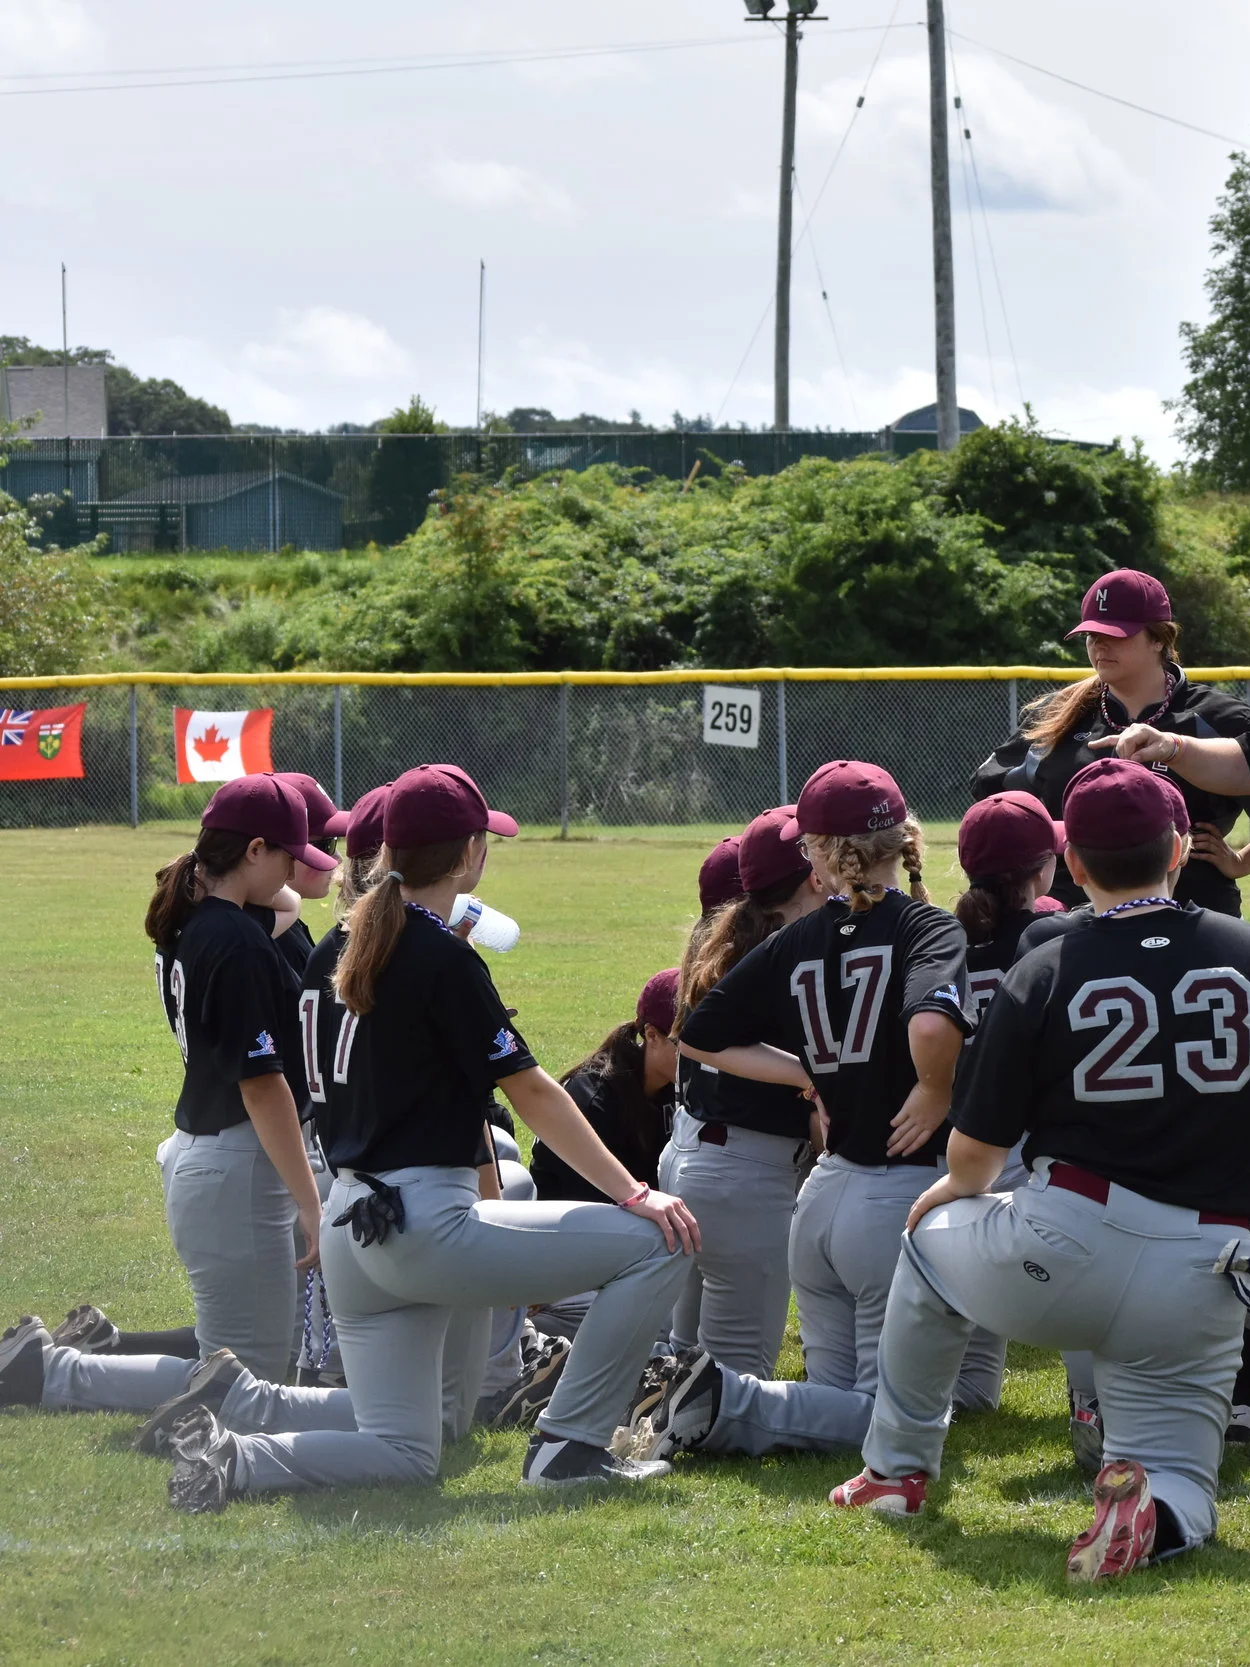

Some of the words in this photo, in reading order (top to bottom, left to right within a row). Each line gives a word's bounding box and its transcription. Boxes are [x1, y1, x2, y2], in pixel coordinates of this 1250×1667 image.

[710, 701, 752, 734] 259
[299, 989, 360, 1103] 17
[790, 945, 893, 1074] 17
